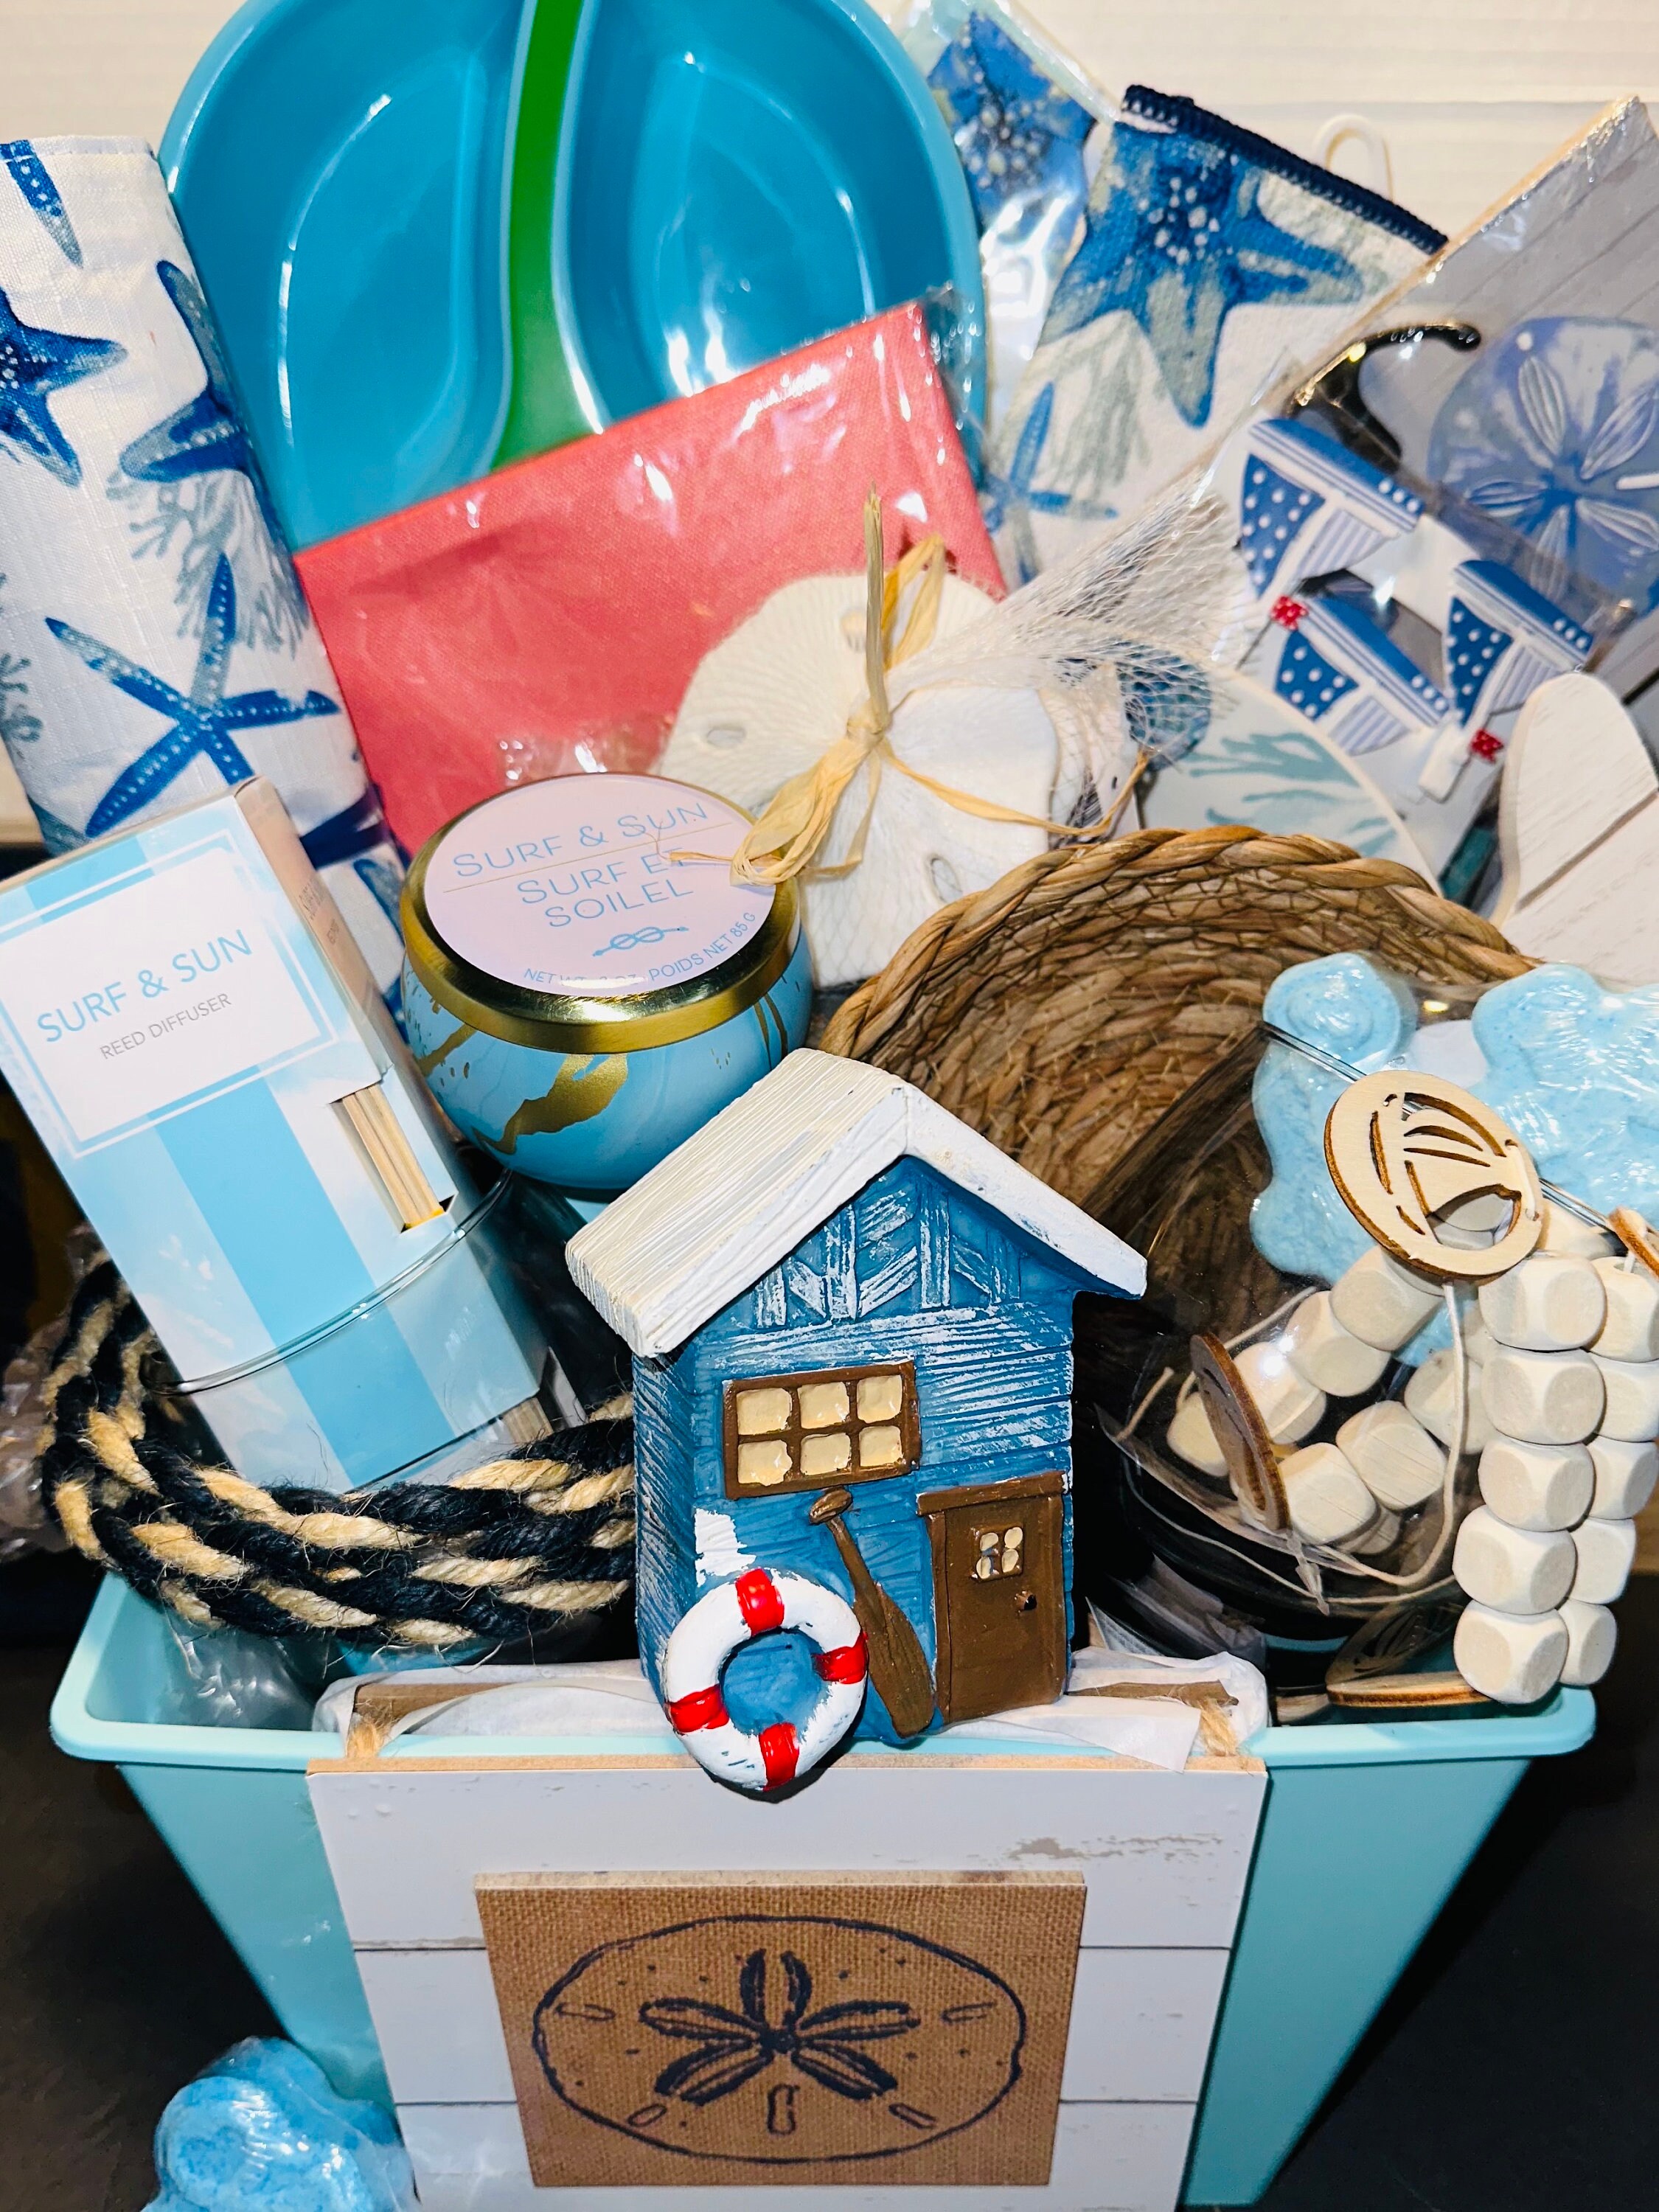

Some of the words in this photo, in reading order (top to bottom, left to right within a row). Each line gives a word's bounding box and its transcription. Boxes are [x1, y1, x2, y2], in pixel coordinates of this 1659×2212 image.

[453, 835, 564, 877] SURF
[579, 825, 608, 847] &
[616, 801, 709, 838] SUN
[517, 860, 629, 904] SURF
[544, 878, 695, 928] SOILEL
[524, 968, 557, 984] NET
[648, 953, 704, 981] POIDS
[703, 933, 733, 959] NET
[730, 922, 748, 938] 85
[742, 912, 756, 922] G
[37, 981, 127, 1042] SURF
[137, 969, 170, 998] &
[172, 929, 253, 983] SUN
[100, 1031, 146, 1060] REED
[148, 993, 232, 1038] DIFFUSER
